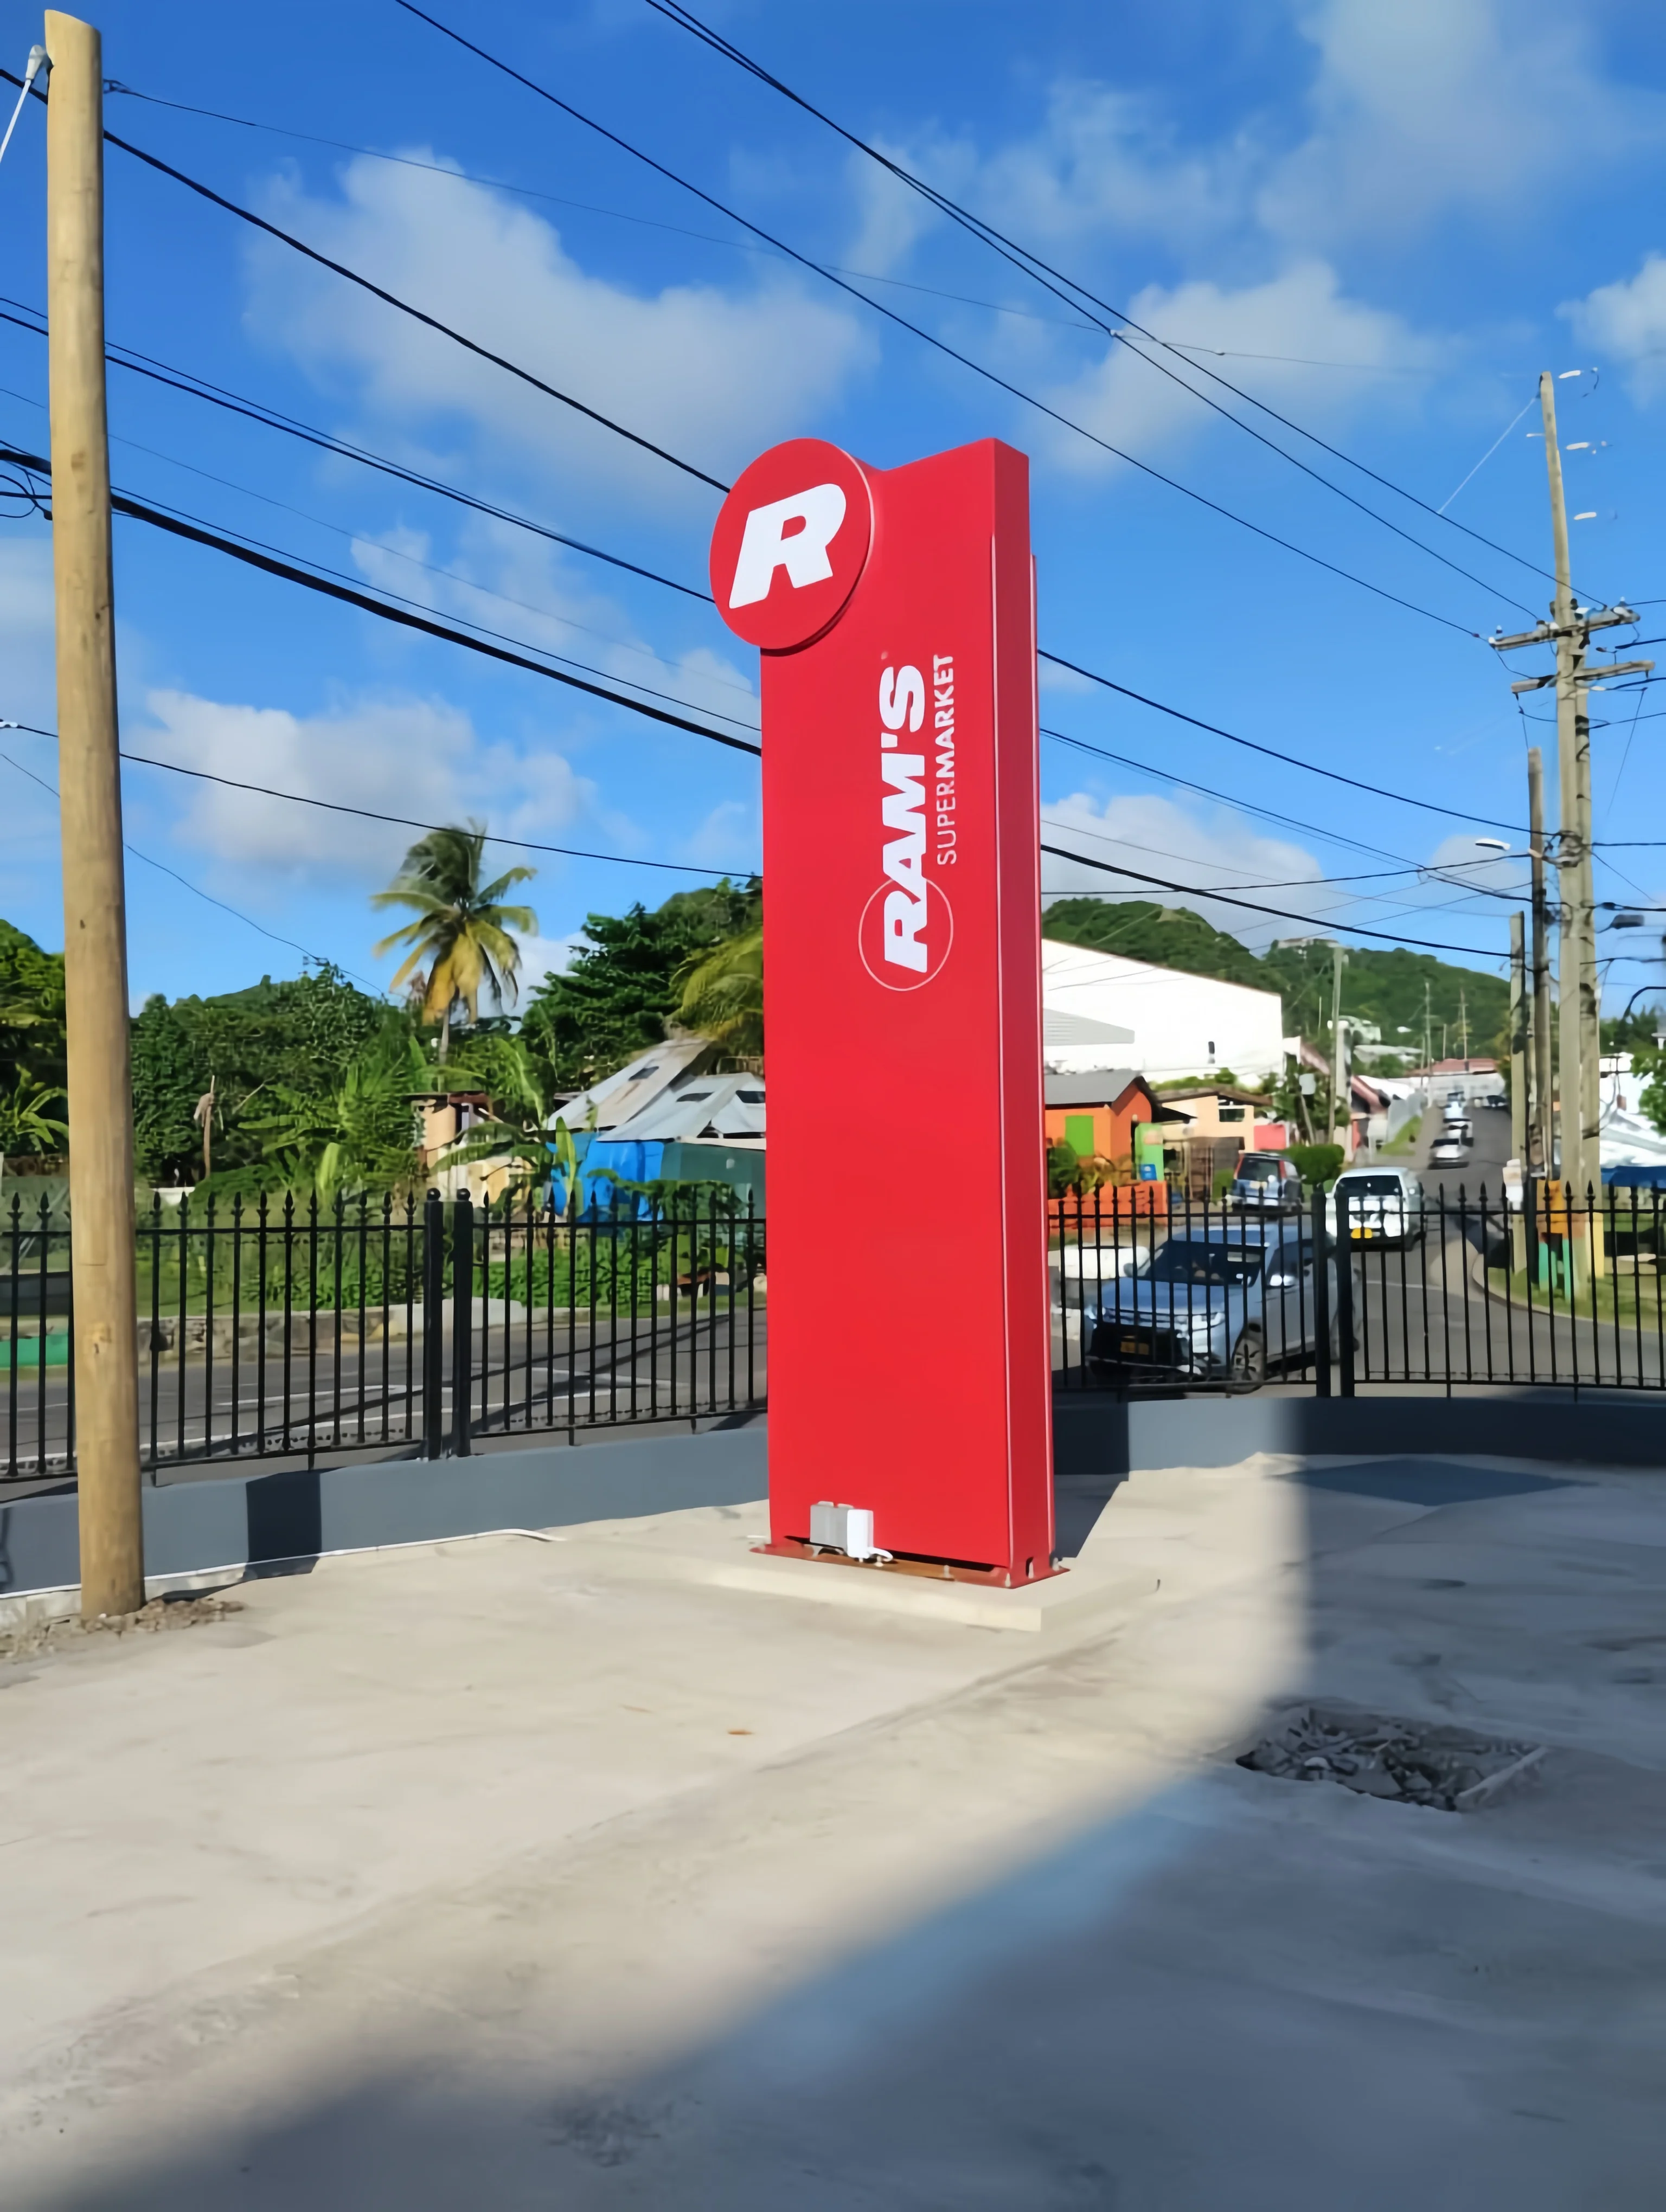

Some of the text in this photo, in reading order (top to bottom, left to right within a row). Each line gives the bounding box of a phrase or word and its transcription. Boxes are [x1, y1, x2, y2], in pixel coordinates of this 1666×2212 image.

[728, 483, 847, 609] R
[879, 665, 928, 974] RAM'S
[933, 654, 957, 865] SUPERMARKET
